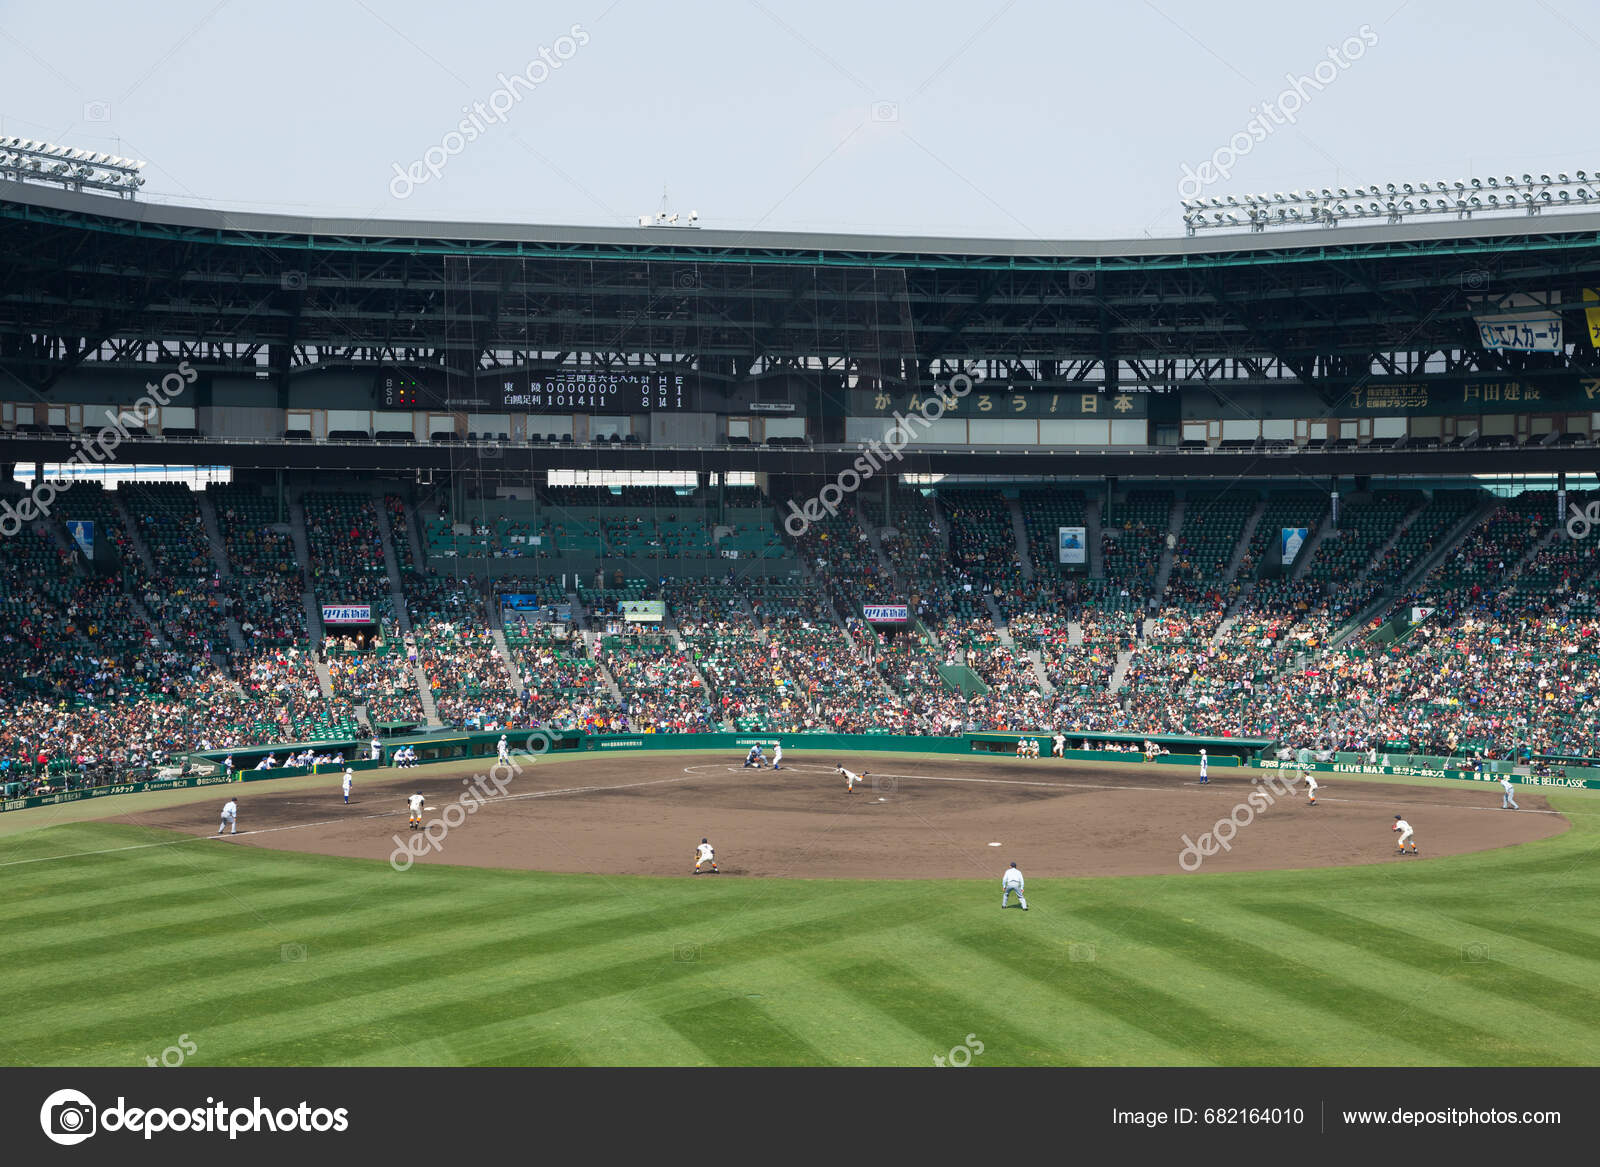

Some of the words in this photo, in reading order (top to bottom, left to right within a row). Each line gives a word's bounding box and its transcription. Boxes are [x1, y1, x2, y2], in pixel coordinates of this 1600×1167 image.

[642, 385, 649, 395] 0
[659, 385, 667, 395] 5
[677, 386, 682, 395] 1
[642, 397, 649, 407] 8
[677, 398, 682, 408] 1
[1363, 765, 1385, 774] MAX
[1525, 775, 1539, 785] THE
